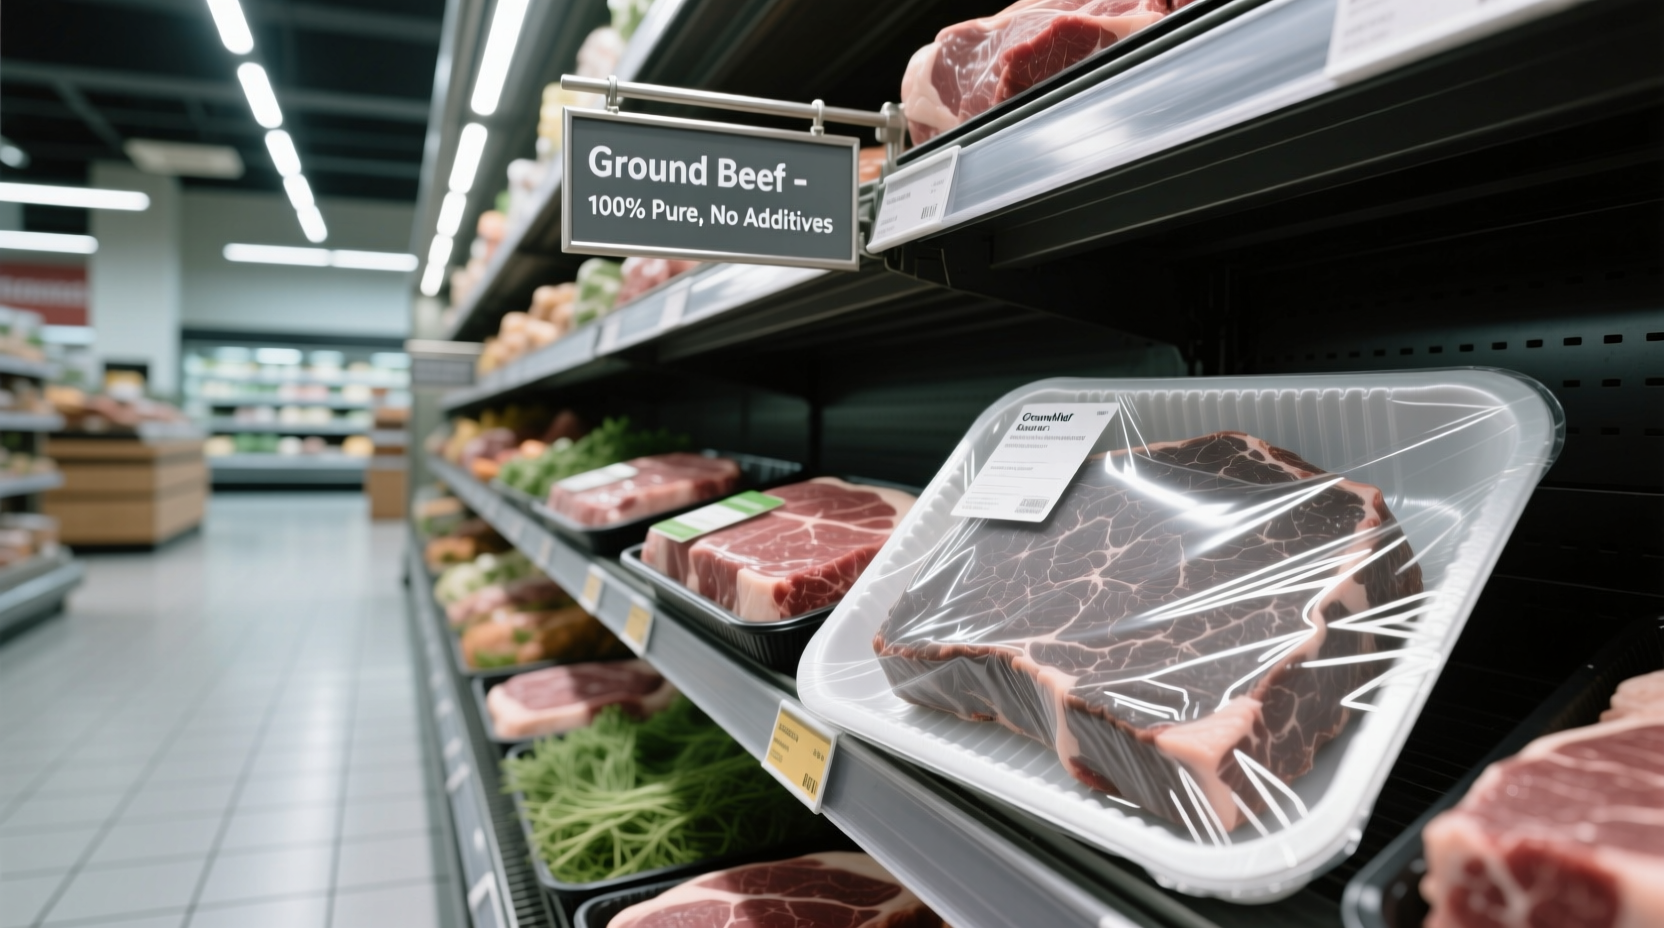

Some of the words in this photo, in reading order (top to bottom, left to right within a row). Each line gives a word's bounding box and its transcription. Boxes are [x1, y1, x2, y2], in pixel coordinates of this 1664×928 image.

[588, 145, 708, 187] Ground
[717, 157, 787, 193] Beef
[587, 194, 646, 219] 100%
[651, 199, 704, 227] Pure,
[710, 204, 739, 226] No
[743, 207, 834, 234] Additives
